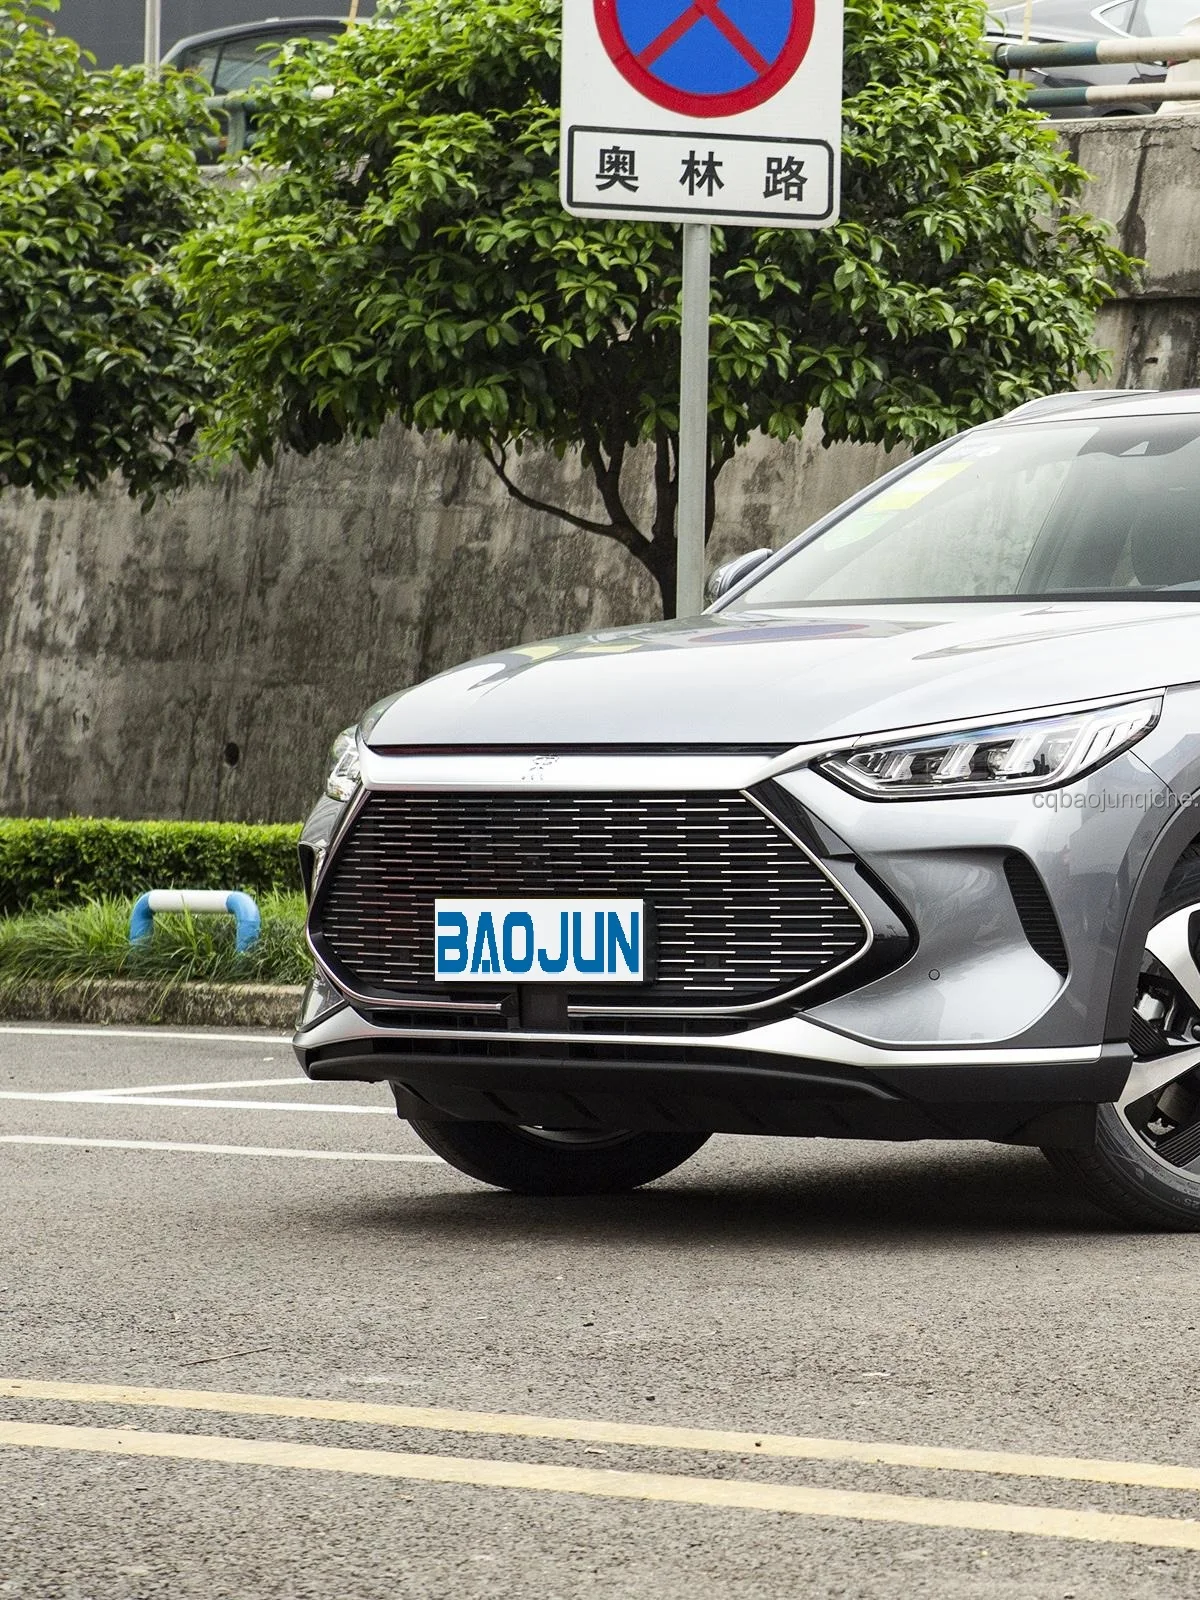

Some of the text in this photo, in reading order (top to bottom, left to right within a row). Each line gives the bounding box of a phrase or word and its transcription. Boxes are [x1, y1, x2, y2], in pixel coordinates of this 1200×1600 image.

[595, 145, 808, 202] 奥林路
[437, 911, 640, 975] BAOJUN
